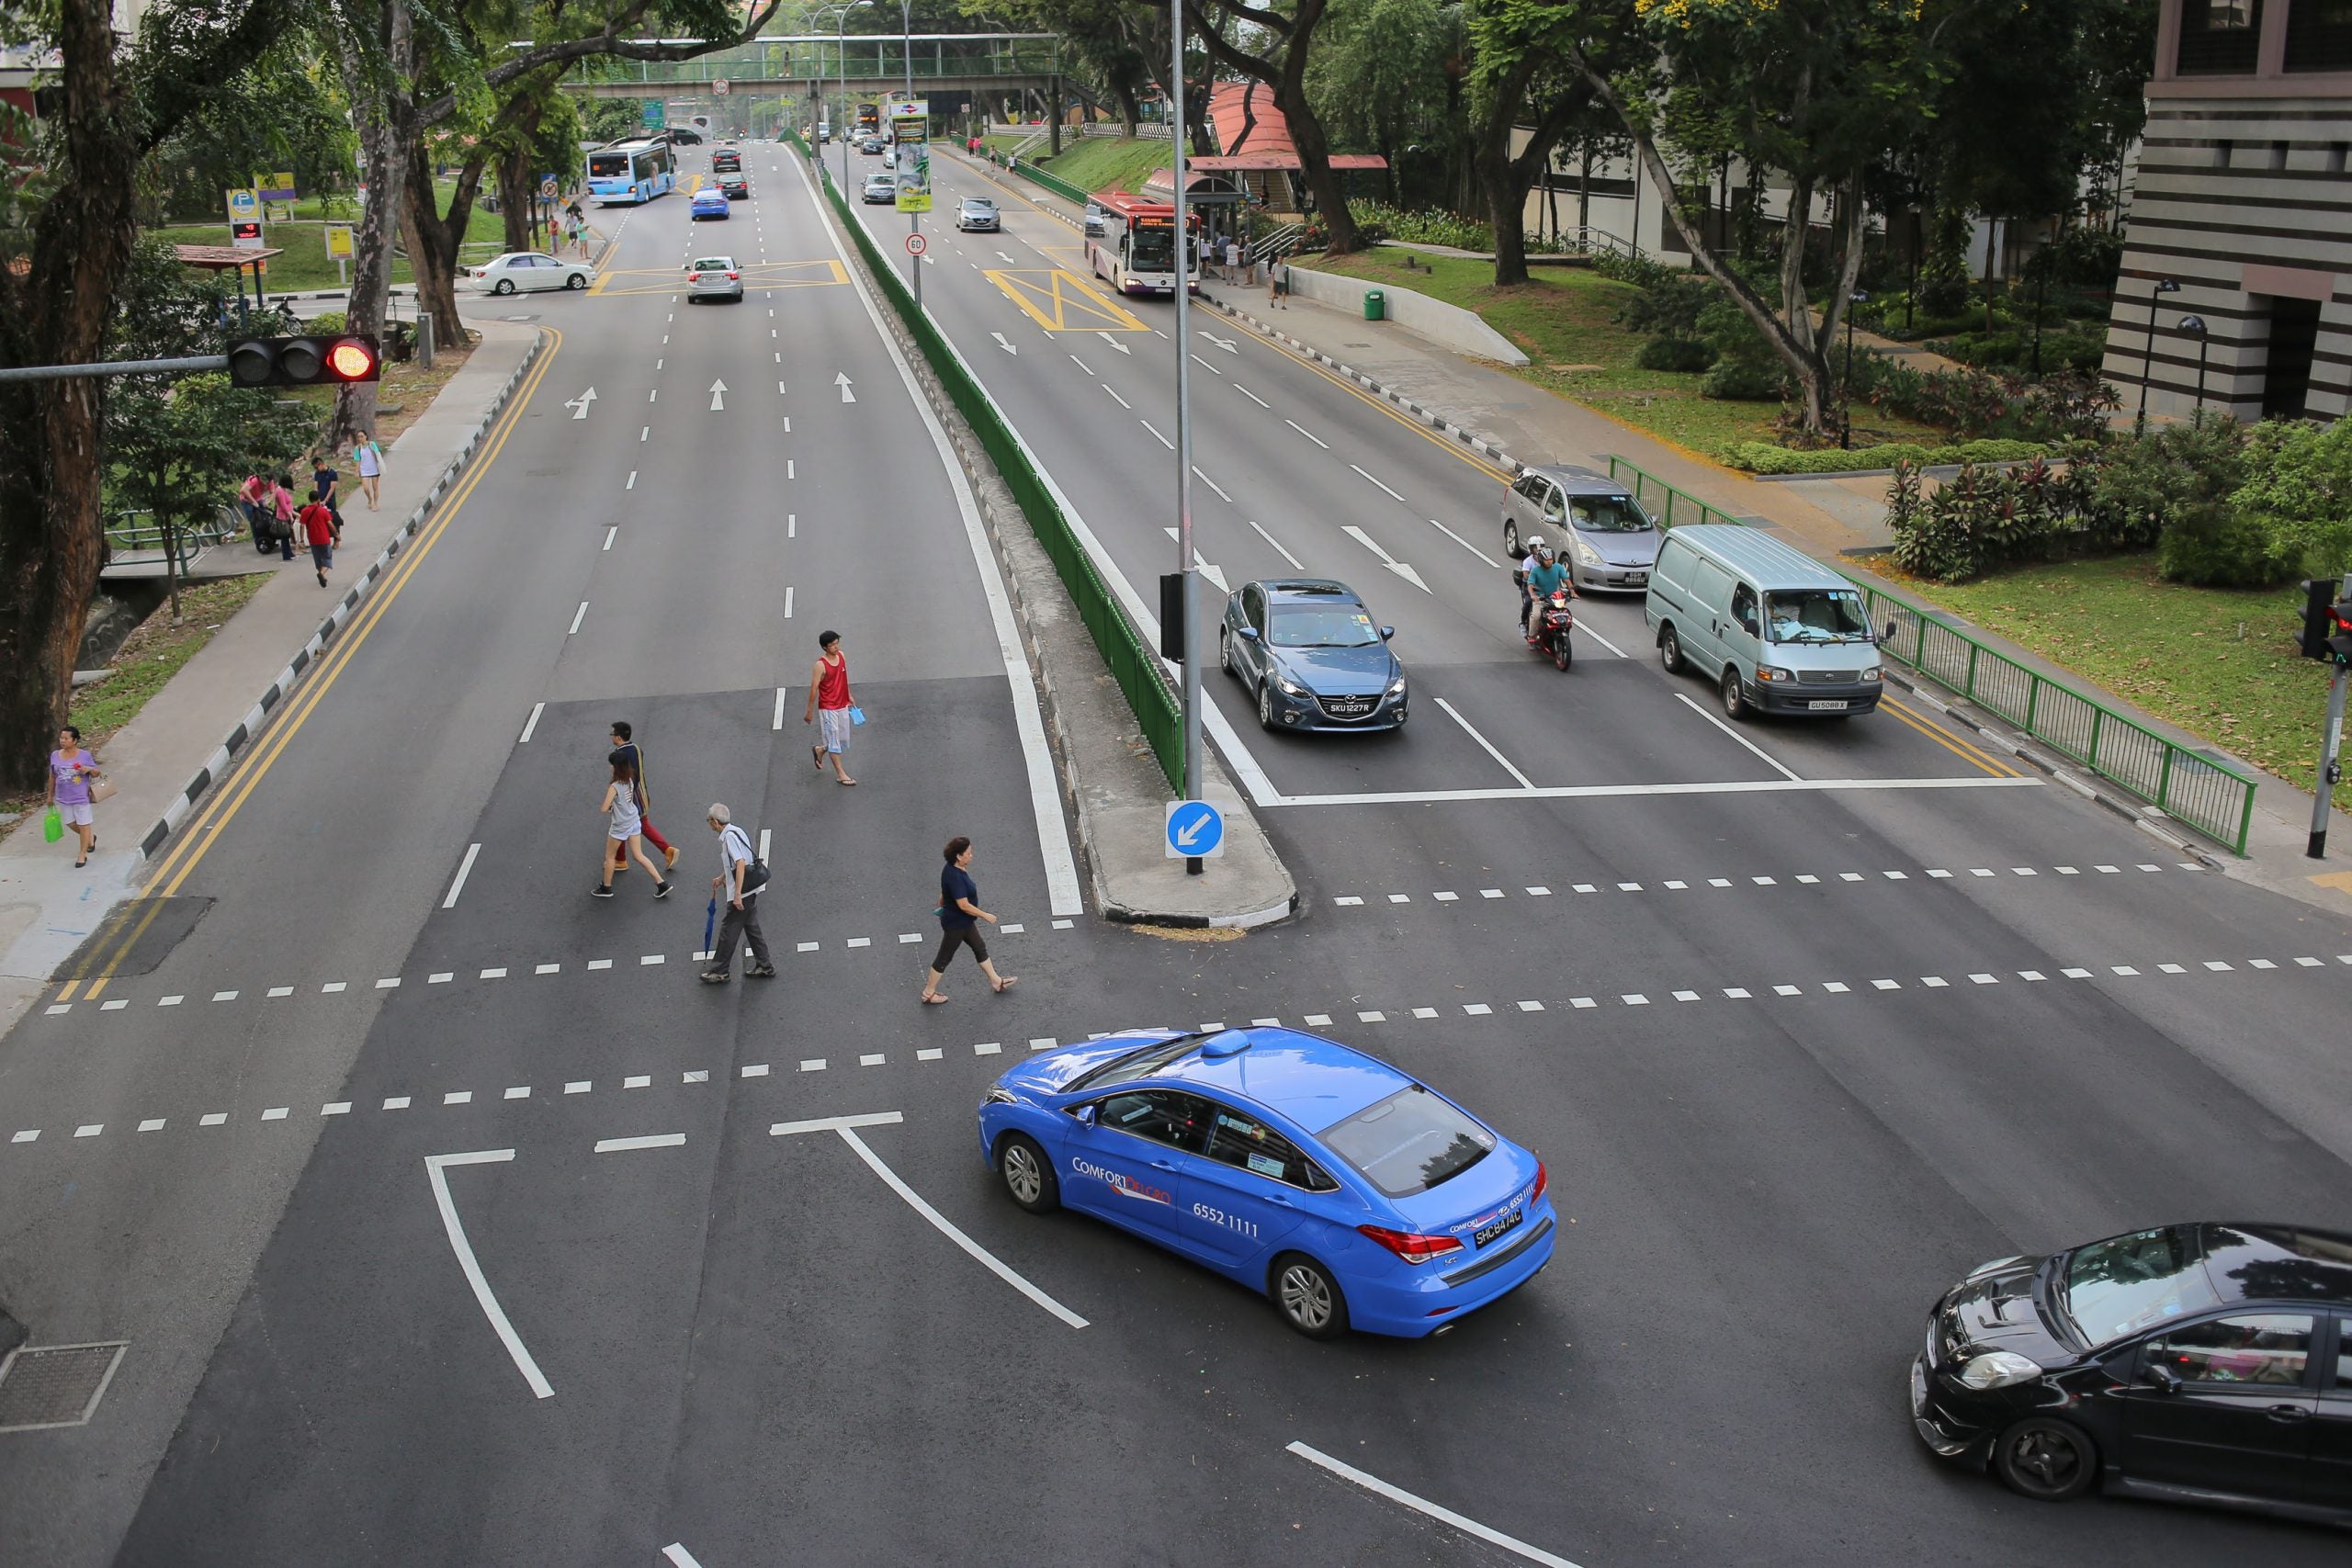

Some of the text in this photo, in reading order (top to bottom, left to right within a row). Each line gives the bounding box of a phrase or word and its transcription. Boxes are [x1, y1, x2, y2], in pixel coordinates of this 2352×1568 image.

[1510, 1193, 1523, 1209] 6552
[1523, 1183, 1533, 1198] 1111
[1193, 1202, 1257, 1237] 6552 1111
[1476, 1210, 1521, 1245] SHC8474C
